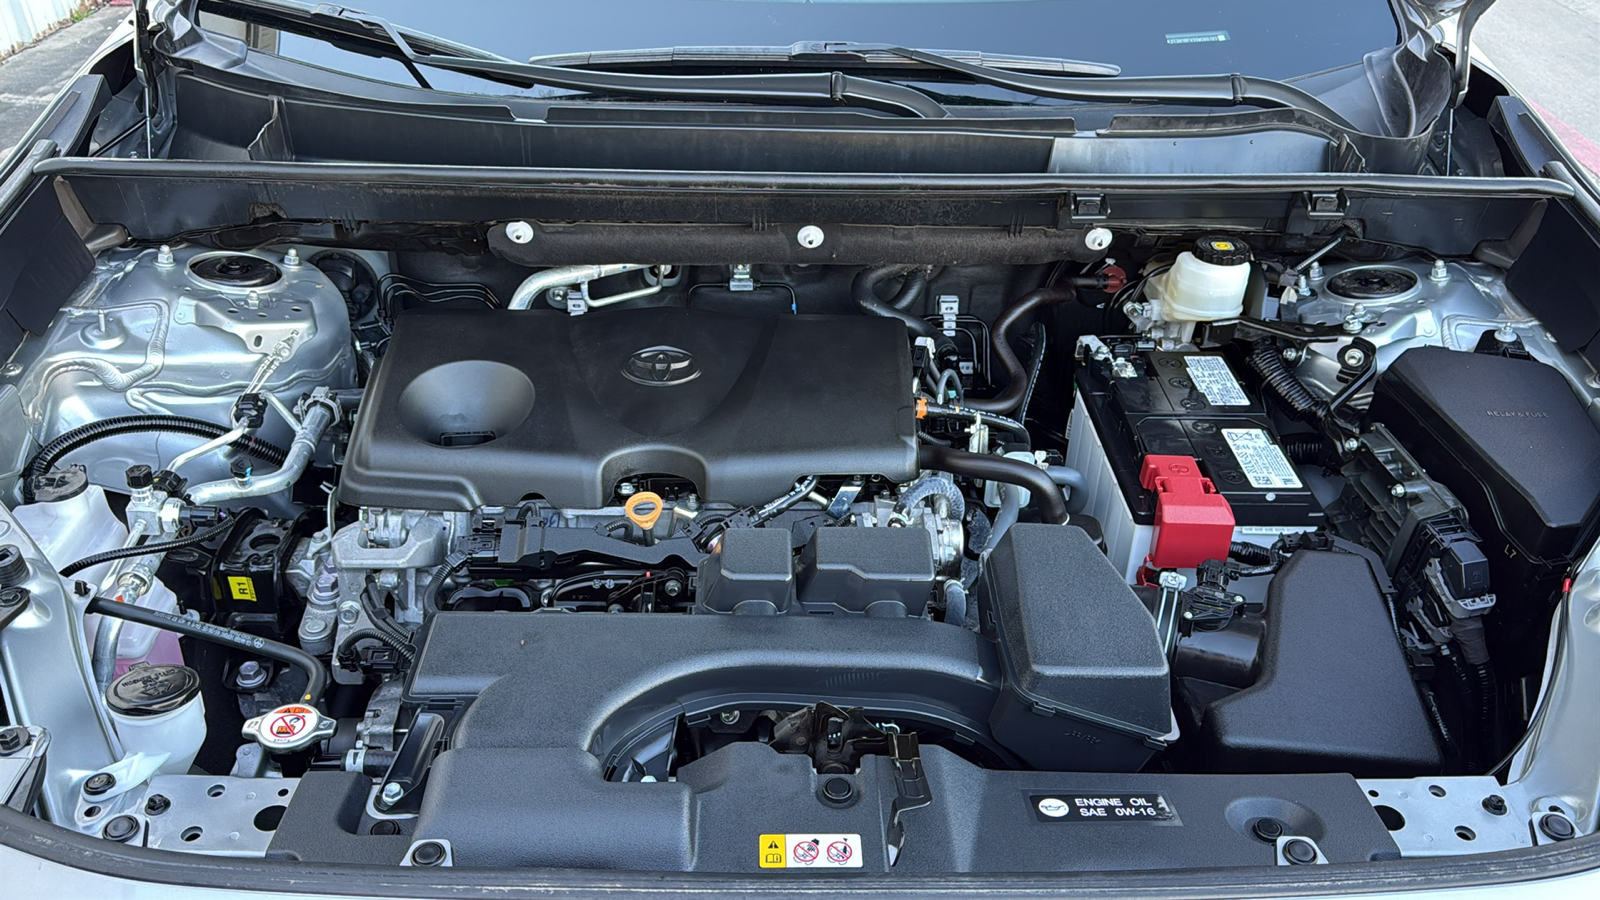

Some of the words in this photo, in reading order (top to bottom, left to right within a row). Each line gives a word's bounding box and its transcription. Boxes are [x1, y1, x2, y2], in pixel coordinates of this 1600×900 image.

[237, 582, 249, 595] R1
[1074, 798, 1123, 806] ENGINE
[1129, 798, 1152, 806] OIL
[1079, 808, 1107, 816] SAE
[1115, 808, 1156, 816] 0W-16
